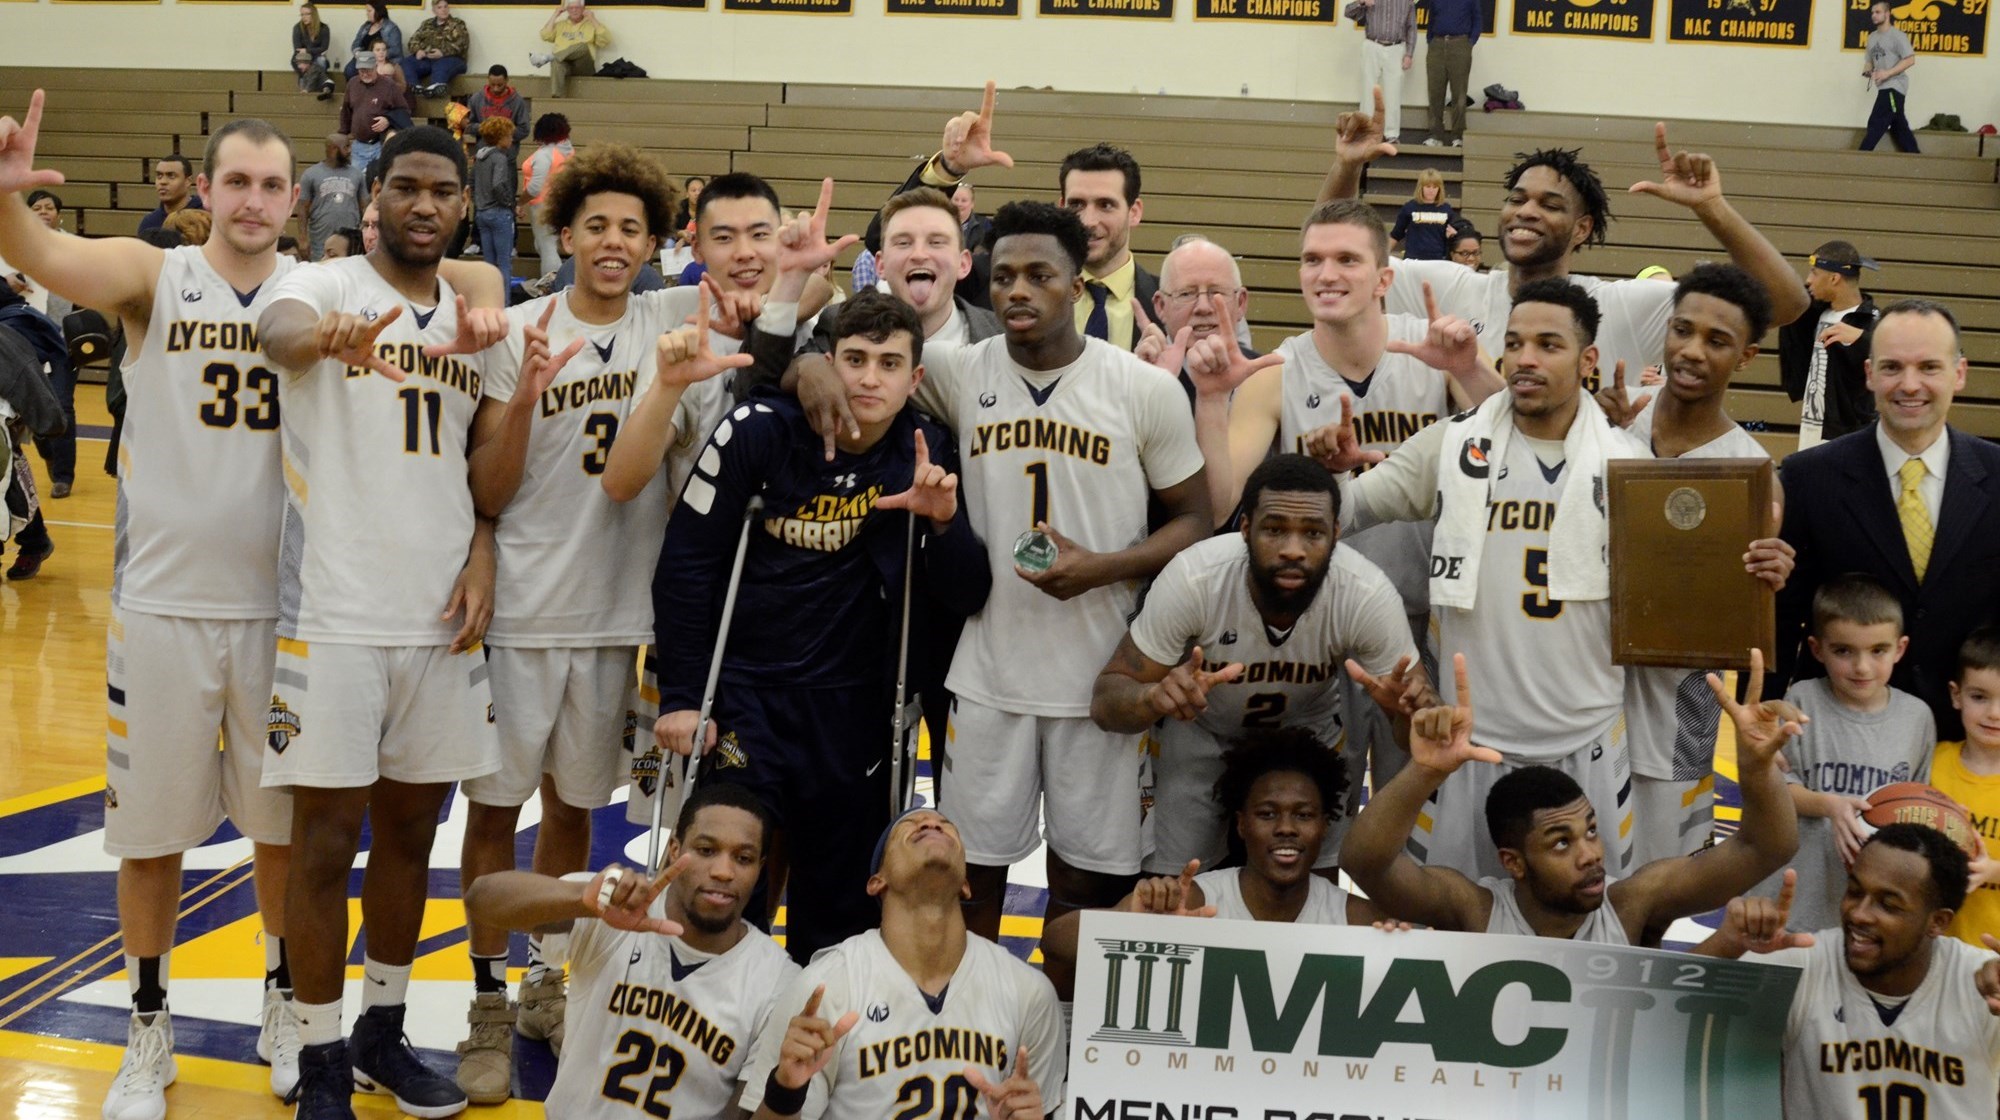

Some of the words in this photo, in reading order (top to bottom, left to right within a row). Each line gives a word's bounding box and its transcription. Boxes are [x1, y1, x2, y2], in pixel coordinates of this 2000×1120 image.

[1210, 0, 1237, 14] MAC
[1246, 0, 1321, 17] CHAMPIONS
[1526, 10, 1554, 28] MAC
[1564, 11, 1639, 32] CHAMPIONS
[1684, 18, 1712, 37] MAC
[1720, 19, 1796, 40] CHAMPIONS
[1892, 20, 1938, 34] WOMEN'S
[1908, 33, 1970, 53] AMPIONS
[166, 320, 262, 353] LYCOM
[199, 361, 281, 432] 33
[397, 385, 442, 458] 11
[581, 411, 620, 478] 3
[969, 418, 1111, 466] LYCOMING
[1024, 460, 1049, 531] 1
[764, 516, 864, 552] WARRI
[1521, 546, 1566, 622] 5
[1242, 691, 1288, 728] 2
[1123, 941, 1176, 955] 1912
[1586, 954, 1707, 988] 912
[1195, 946, 1572, 1068] MAC
[601, 1027, 688, 1120] 22
[858, 1027, 1008, 1080] LYCOMING
[1084, 1047, 1563, 1092] COMMONWEALTH
[1820, 1037, 1966, 1087] LYCOMING
[893, 1072, 980, 1120] 20
